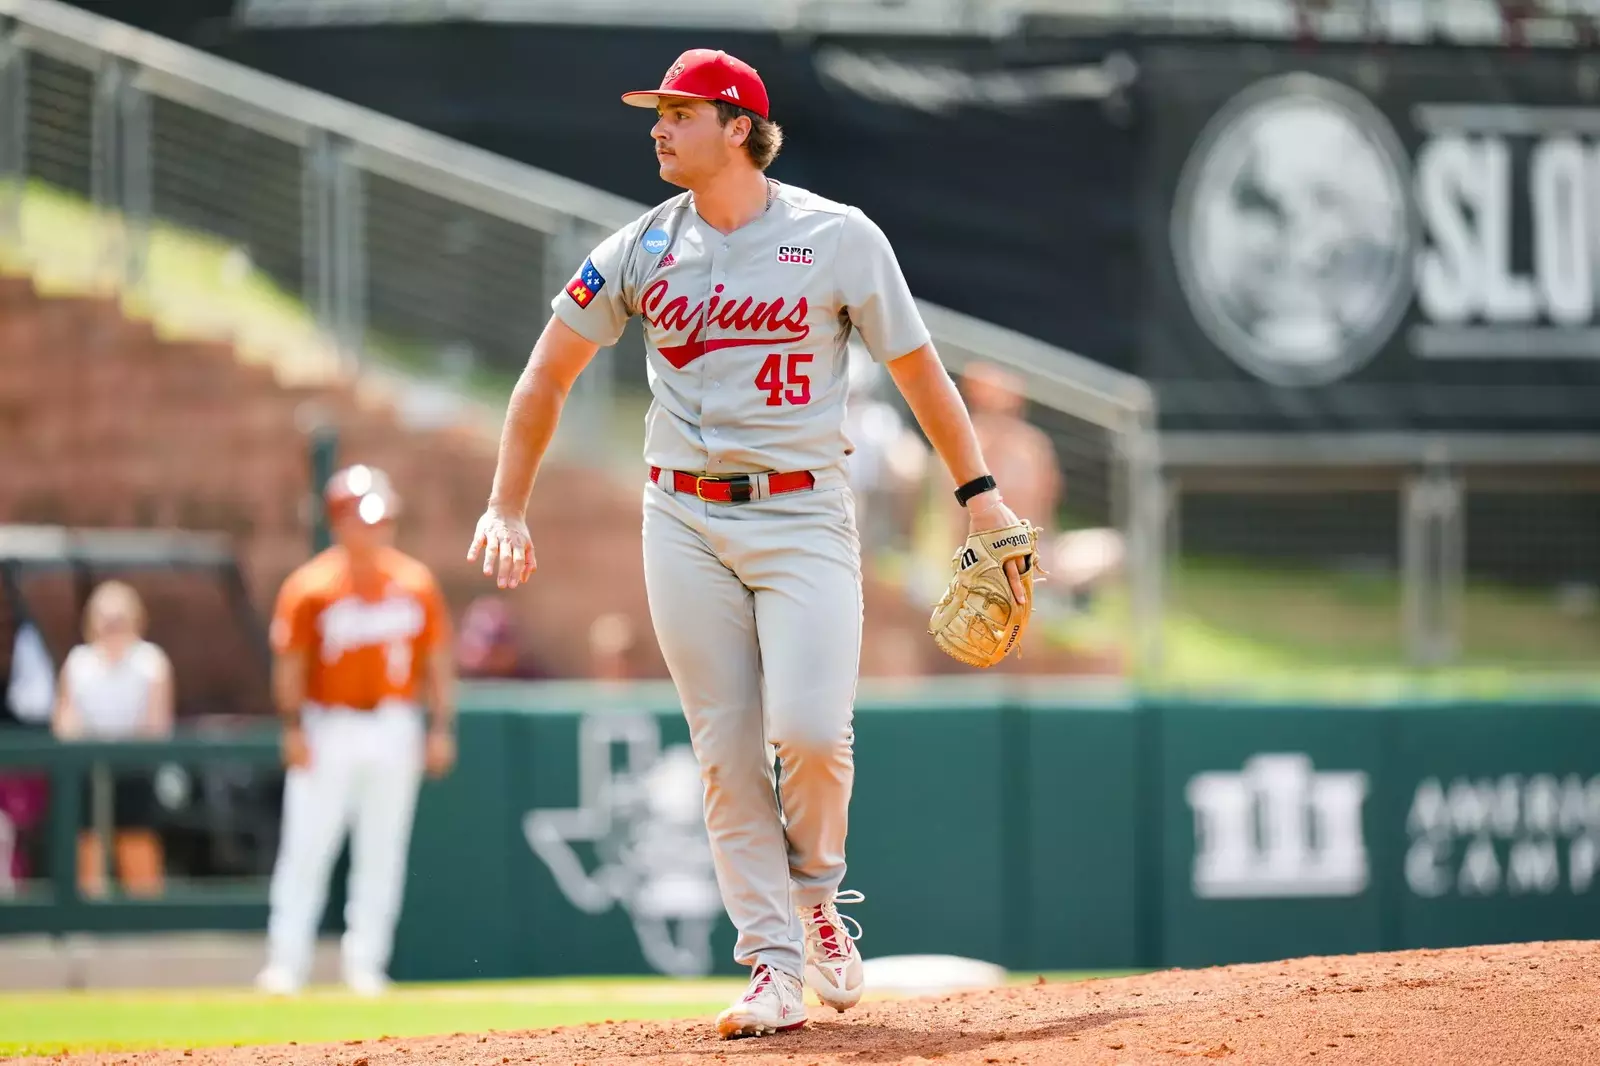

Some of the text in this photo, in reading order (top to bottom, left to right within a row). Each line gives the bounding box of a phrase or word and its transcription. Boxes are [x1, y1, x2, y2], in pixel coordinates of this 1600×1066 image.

[646, 240, 668, 248] NCAA
[1416, 135, 1600, 322] SLO
[778, 246, 813, 264] SBC
[641, 280, 811, 362] Cajuns
[754, 353, 813, 406] 45
[992, 534, 1028, 549] Wilson
